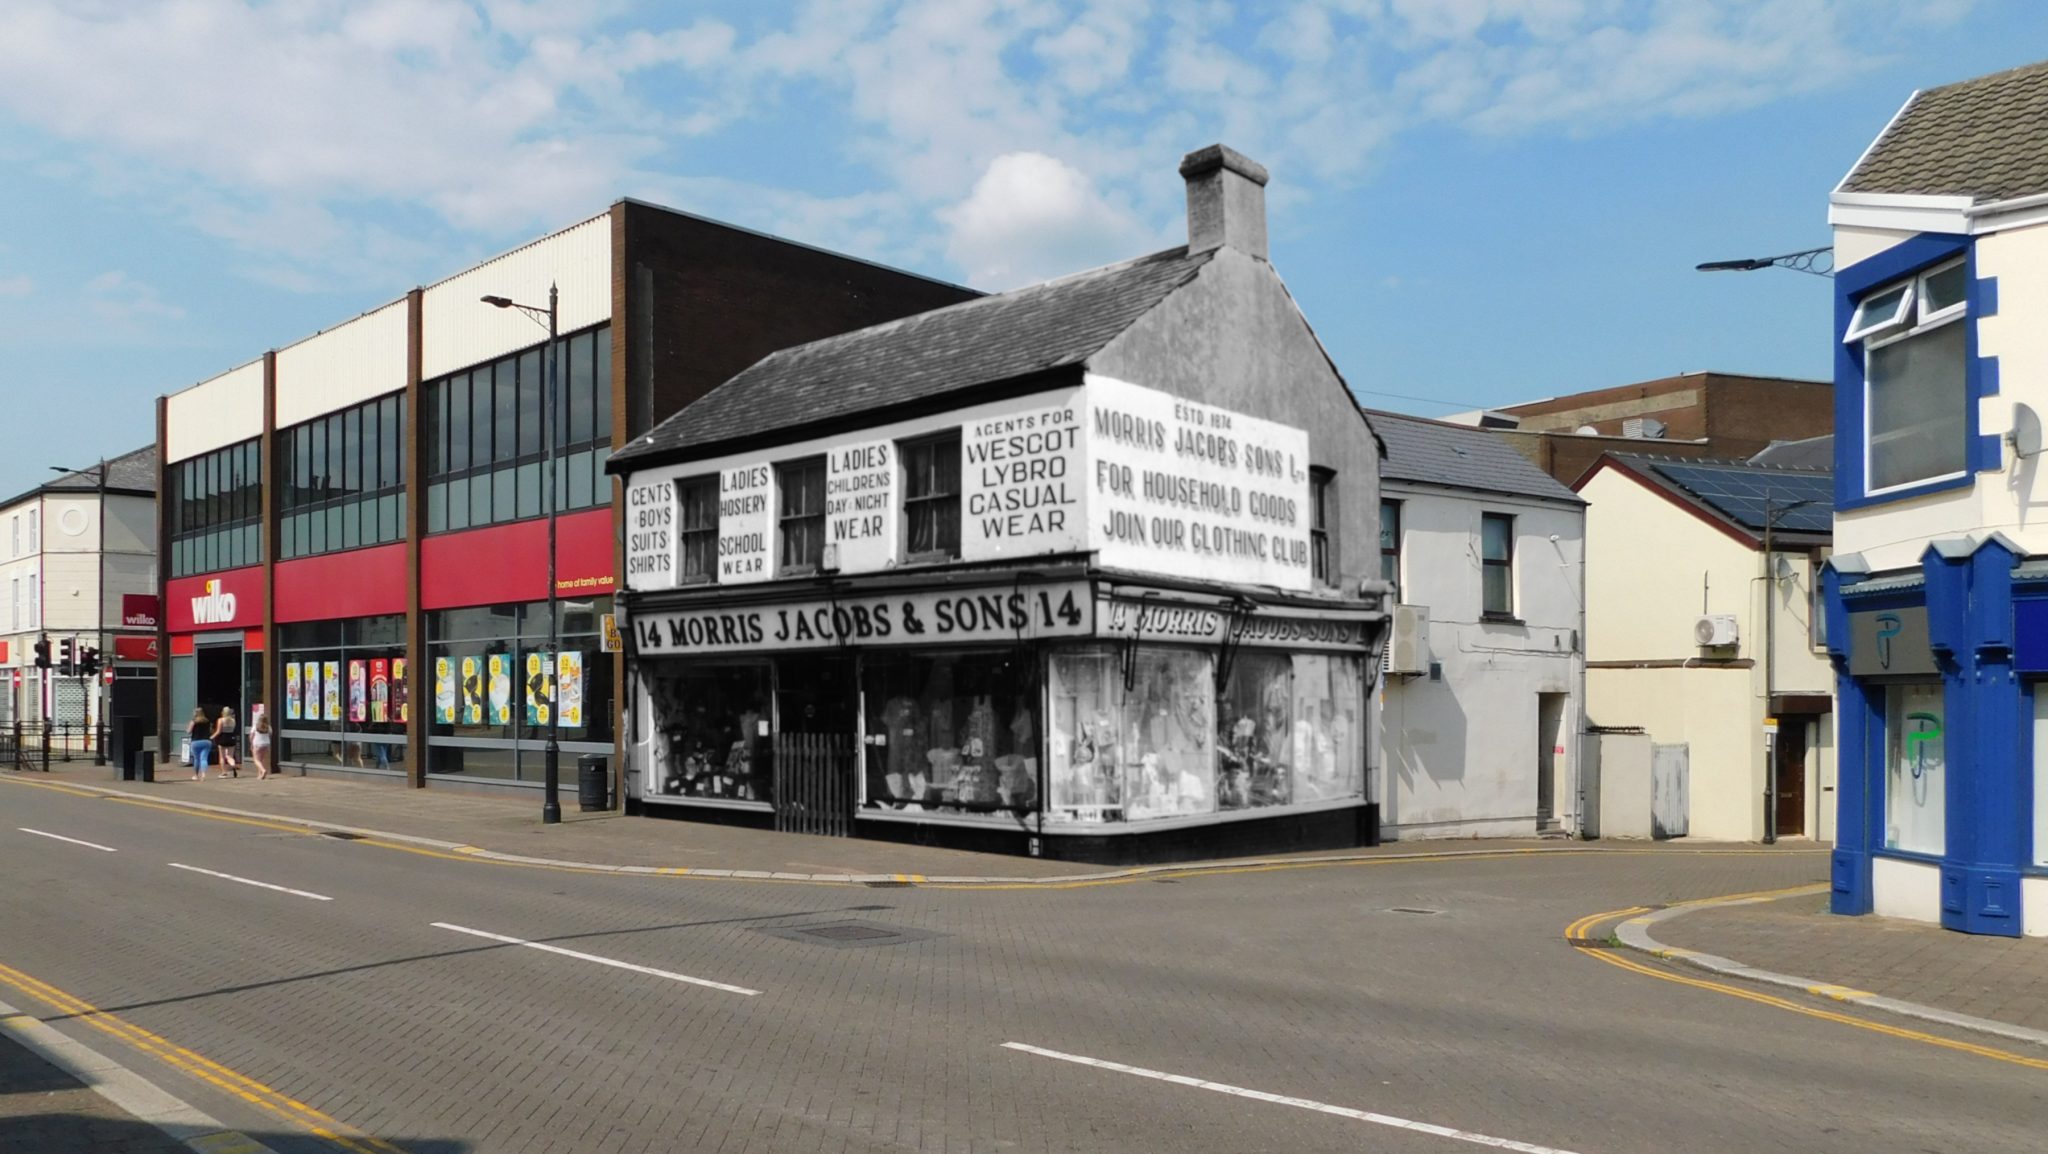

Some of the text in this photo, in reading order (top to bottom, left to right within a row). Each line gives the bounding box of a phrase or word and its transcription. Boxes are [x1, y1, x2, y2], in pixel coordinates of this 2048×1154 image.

[976, 409, 1073, 437] AGENTS FOR
[1175, 404, 1232, 430] ESTD 1874
[967, 426, 1080, 464] WESCOT
[1095, 406, 1166, 451] MORRIS
[1175, 426, 1237, 466] JACOBS
[1245, 443, 1284, 478] SONS
[832, 444, 887, 474] LADIES
[983, 456, 1066, 487] LYBRO
[722, 467, 768, 492] LADIES
[1096, 459, 1134, 498] FOR
[1144, 470, 1243, 516] HOUSEHOLD
[720, 494, 767, 517] HOSIERY
[827, 498, 848, 515] DAY
[855, 493, 889, 511] NIGHT
[970, 482, 1077, 515] CASUAL
[640, 507, 671, 528] BOYS
[834, 515, 883, 540] WEAR
[982, 510, 1065, 539] WEAR
[632, 531, 667, 552] SUITS
[720, 533, 766, 556] SCHOOL
[1103, 509, 1146, 544] JOIN
[1152, 516, 1186, 549] OUR
[1273, 535, 1309, 568] CLUB
[630, 554, 671, 574] SHIRTS
[723, 558, 763, 575] WEAR
[557, 575, 614, 589] home of family value
[192, 579, 236, 624] wilko
[126, 613, 155, 625] wilko
[638, 589, 1083, 648] 14 MORRIS JACOBS & SONS 14
[1134, 606, 1218, 636] MORRIS
